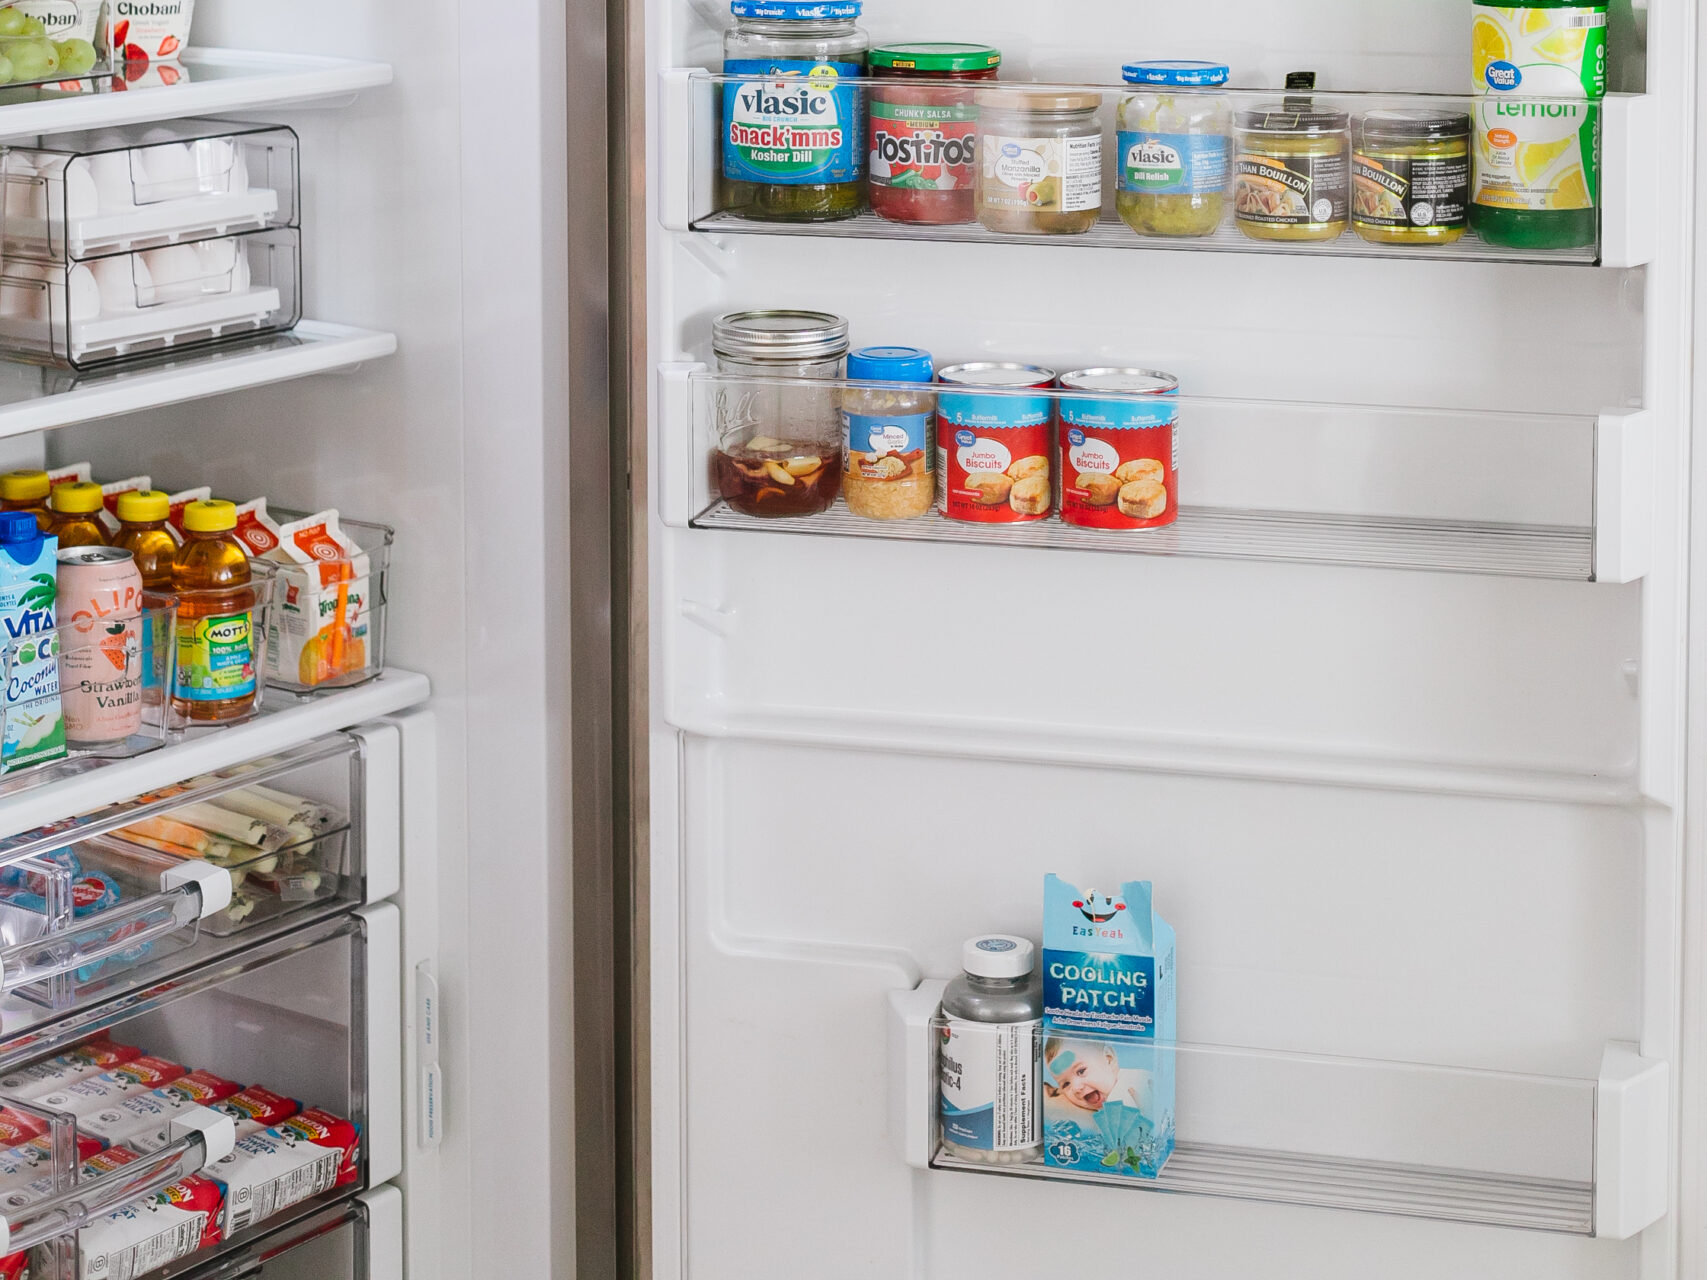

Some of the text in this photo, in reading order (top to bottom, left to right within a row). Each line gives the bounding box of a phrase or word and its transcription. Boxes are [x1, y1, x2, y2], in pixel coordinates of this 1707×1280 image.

[117, 0, 182, 16] Chobani
[1488, 66, 1515, 78] Great
[1593, 44, 1605, 95] uice
[1493, 76, 1515, 85] Value
[741, 89, 827, 115] vlasic
[895, 108, 952, 119] CHUNKY SALSA
[730, 124, 842, 148] Snack'mms
[751, 149, 813, 163] Kosher Dill
[1131, 150, 1175, 164] vlasic
[1001, 164, 1041, 173] Manzanilla
[1134, 172, 1169, 181] Dill Relish
[1240, 163, 1257, 174] THAN
[1259, 166, 1310, 193] BOUILLON
[1362, 166, 1405, 194] BOUILLON
[956, 412, 963, 423] 5
[1068, 410, 1074, 421] 5
[1082, 413, 1106, 421] Buttermilk
[972, 451, 996, 459] Jumbo
[1081, 451, 1104, 459] Jumbo
[965, 458, 1002, 469] Biscuits
[1076, 458, 1110, 470] Biscuits
[71, 586, 143, 633] OLIPO
[319, 593, 359, 617] Tropna
[4, 607, 55, 638] VITA
[212, 646, 232, 654] 100%
[7, 658, 57, 702] Coconu
[80, 677, 142, 694] Strawbe
[35, 680, 58, 696] WATER
[23, 702, 33, 710] THE
[96, 690, 140, 708] Vanilla
[1050, 963, 1148, 988] COOLING
[1061, 987, 1136, 1009] PATCH
[296, 1115, 331, 1139] ORIZON
[1058, 1145, 1071, 1157] 16
